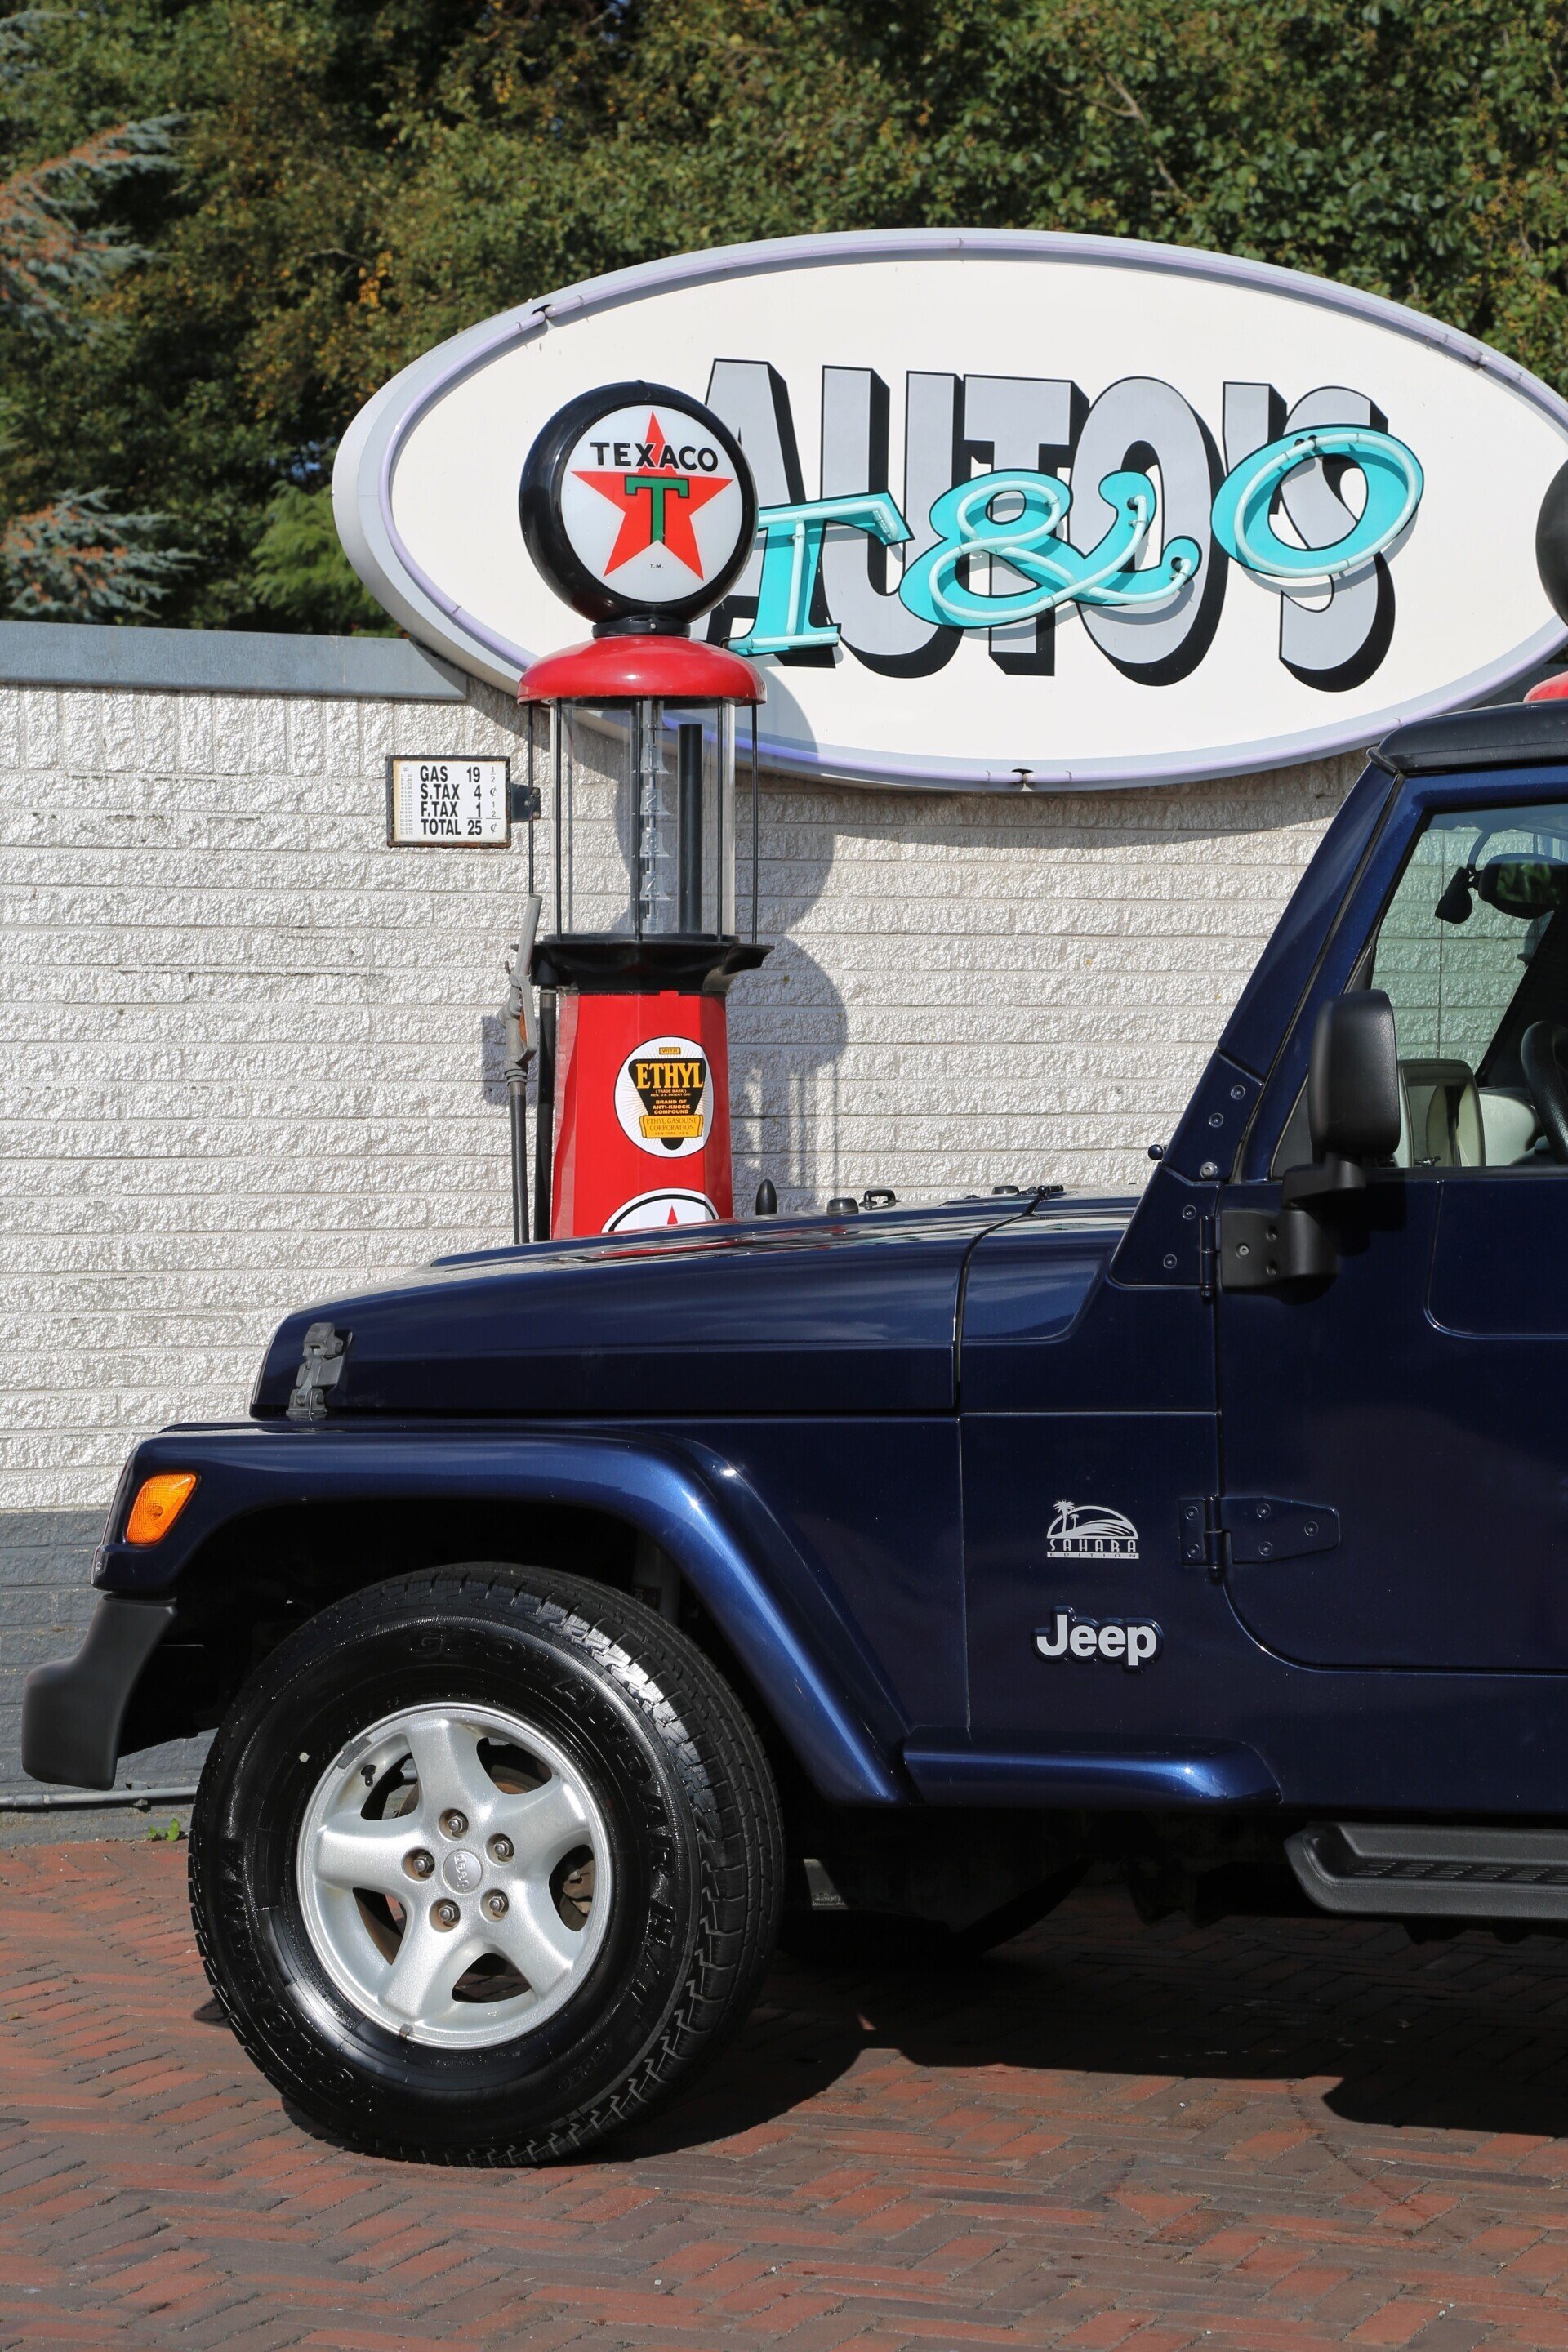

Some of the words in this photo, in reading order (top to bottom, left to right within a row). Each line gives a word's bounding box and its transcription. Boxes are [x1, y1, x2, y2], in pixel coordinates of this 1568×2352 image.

[589, 441, 719, 472] TEXACO
[623, 474, 690, 546] T
[420, 765, 448, 782] GAS
[466, 766, 481, 783] 19
[420, 783, 460, 800] S.TAX
[474, 785, 482, 800] 4
[421, 801, 458, 817] F.TAX
[475, 801, 481, 817] 1
[421, 818, 461, 835] TOTAL
[467, 819, 482, 835] 25
[635, 1062, 704, 1089] ETHYL
[649, 1124, 694, 1132] CORPORATION
[666, 1116, 698, 1125] GASOLINE
[1049, 1538, 1137, 1553] SAHARA
[1036, 1613, 1158, 1667] Jeep
